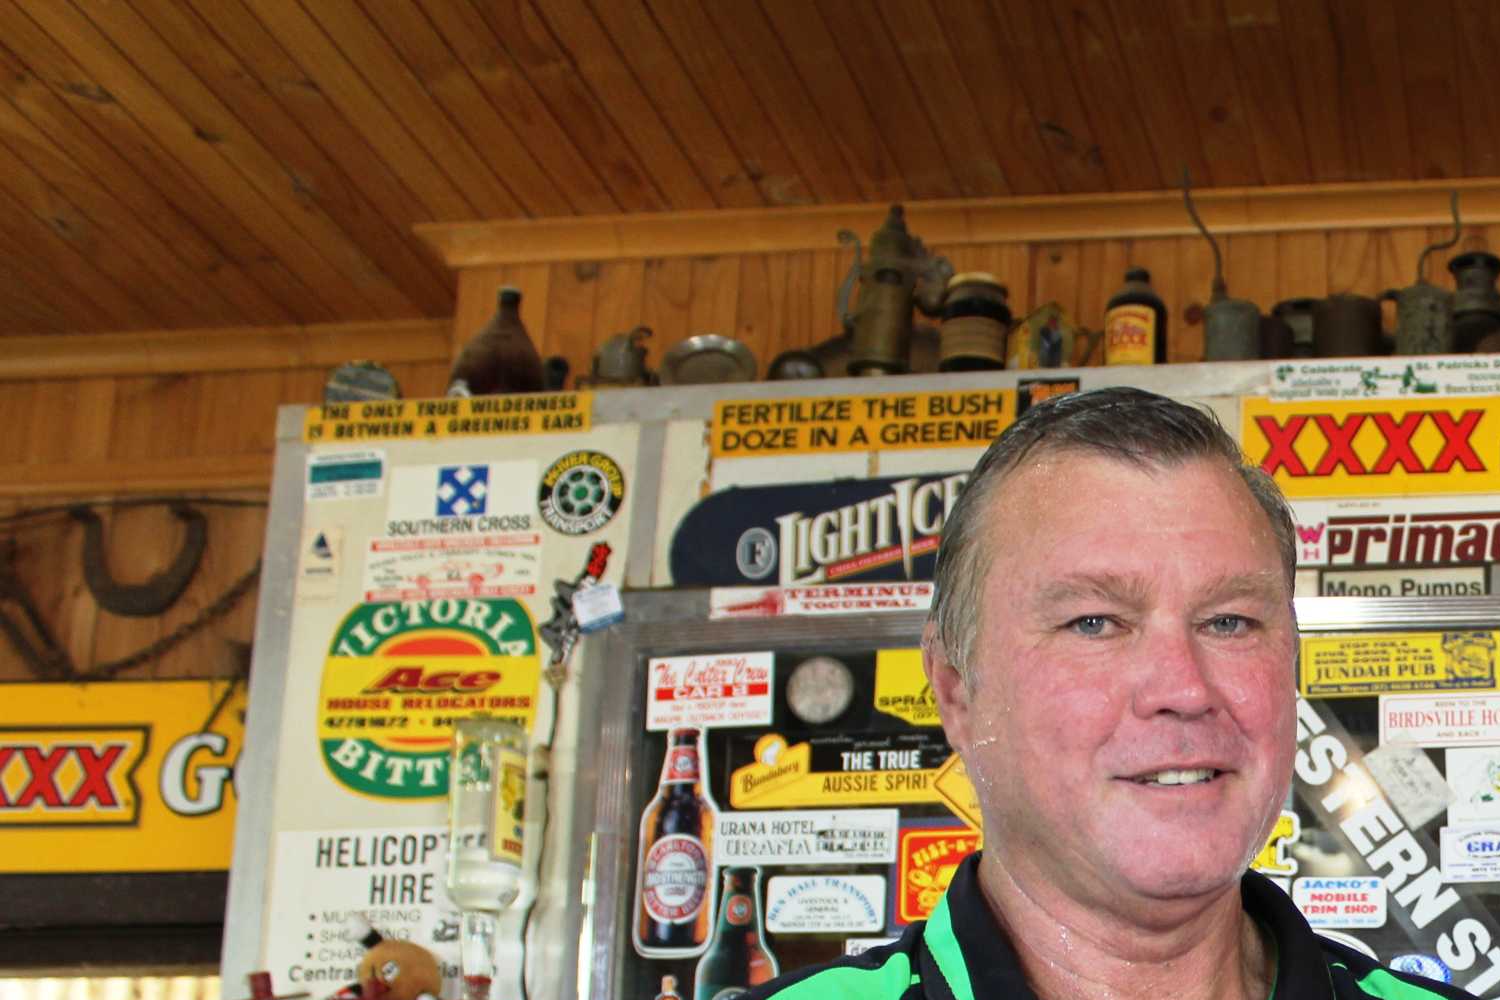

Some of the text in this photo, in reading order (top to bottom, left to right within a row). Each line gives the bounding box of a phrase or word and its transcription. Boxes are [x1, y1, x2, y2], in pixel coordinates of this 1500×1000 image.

[321, 394, 578, 420] THE ONLY TRUE WILDERNESS
[720, 393, 1004, 426] FERTILIZE THE BUSH
[335, 421, 413, 439] BETWEEN
[425, 420, 437, 435] A
[447, 415, 531, 434] GREENIES
[541, 412, 584, 430] EARS
[720, 418, 1001, 453] DOZE IN A GREENIE
[1253, 408, 1488, 478] XXXX
[387, 515, 532, 536] SOUTHERN CROSS
[540, 499, 614, 536] TRANSPORT
[784, 585, 932, 600] TERMINUS
[1326, 578, 1482, 598] Mono Pumps
[364, 666, 503, 693] Ace
[1314, 661, 1437, 681] JUNDAH PUB
[327, 697, 392, 710] HOUSE
[1387, 707, 1477, 731] BIRDSVILLE
[841, 749, 923, 771] THE TRUE
[822, 774, 879, 792] AUSSIE
[1295, 690, 1463, 930] ESTERN
[720, 818, 817, 837] URANA HOTEL
[368, 873, 435, 904] HIRE
[1301, 879, 1379, 890] JACKO'S
[1308, 892, 1369, 903] MOBILE
[1303, 904, 1379, 915] TRIM SHOP
